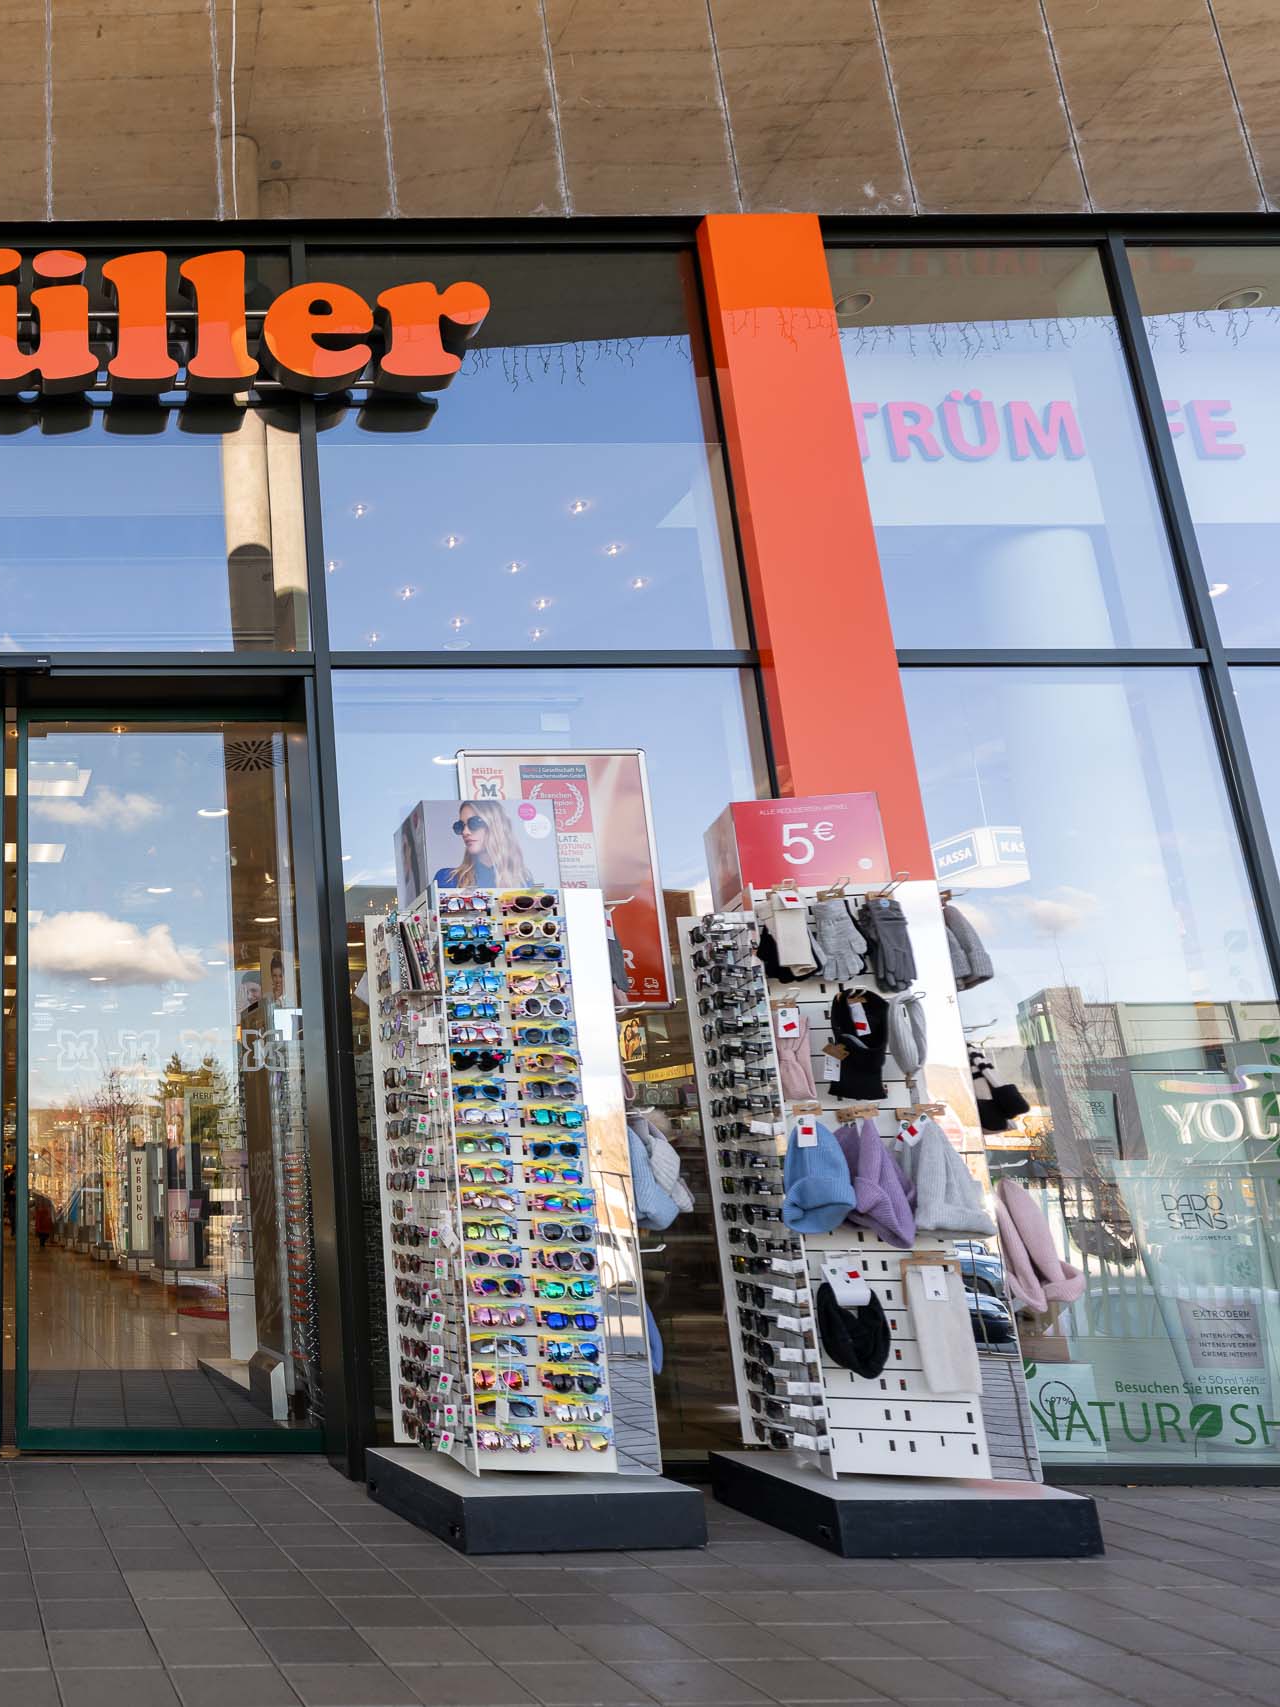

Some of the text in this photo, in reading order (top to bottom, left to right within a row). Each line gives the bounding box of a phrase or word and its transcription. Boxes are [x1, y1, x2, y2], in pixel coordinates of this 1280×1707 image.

[471, 767, 504, 776] Müller
[938, 847, 973, 868] KASSA
[134, 1156, 144, 1221] WERBUNG
[1161, 1194, 1223, 1211] DADO
[1167, 1212, 1228, 1230] SENS
[1192, 1310, 1251, 1319] EXTRODERM
[1115, 1381, 1260, 1396] Besuchen Sie unseren
